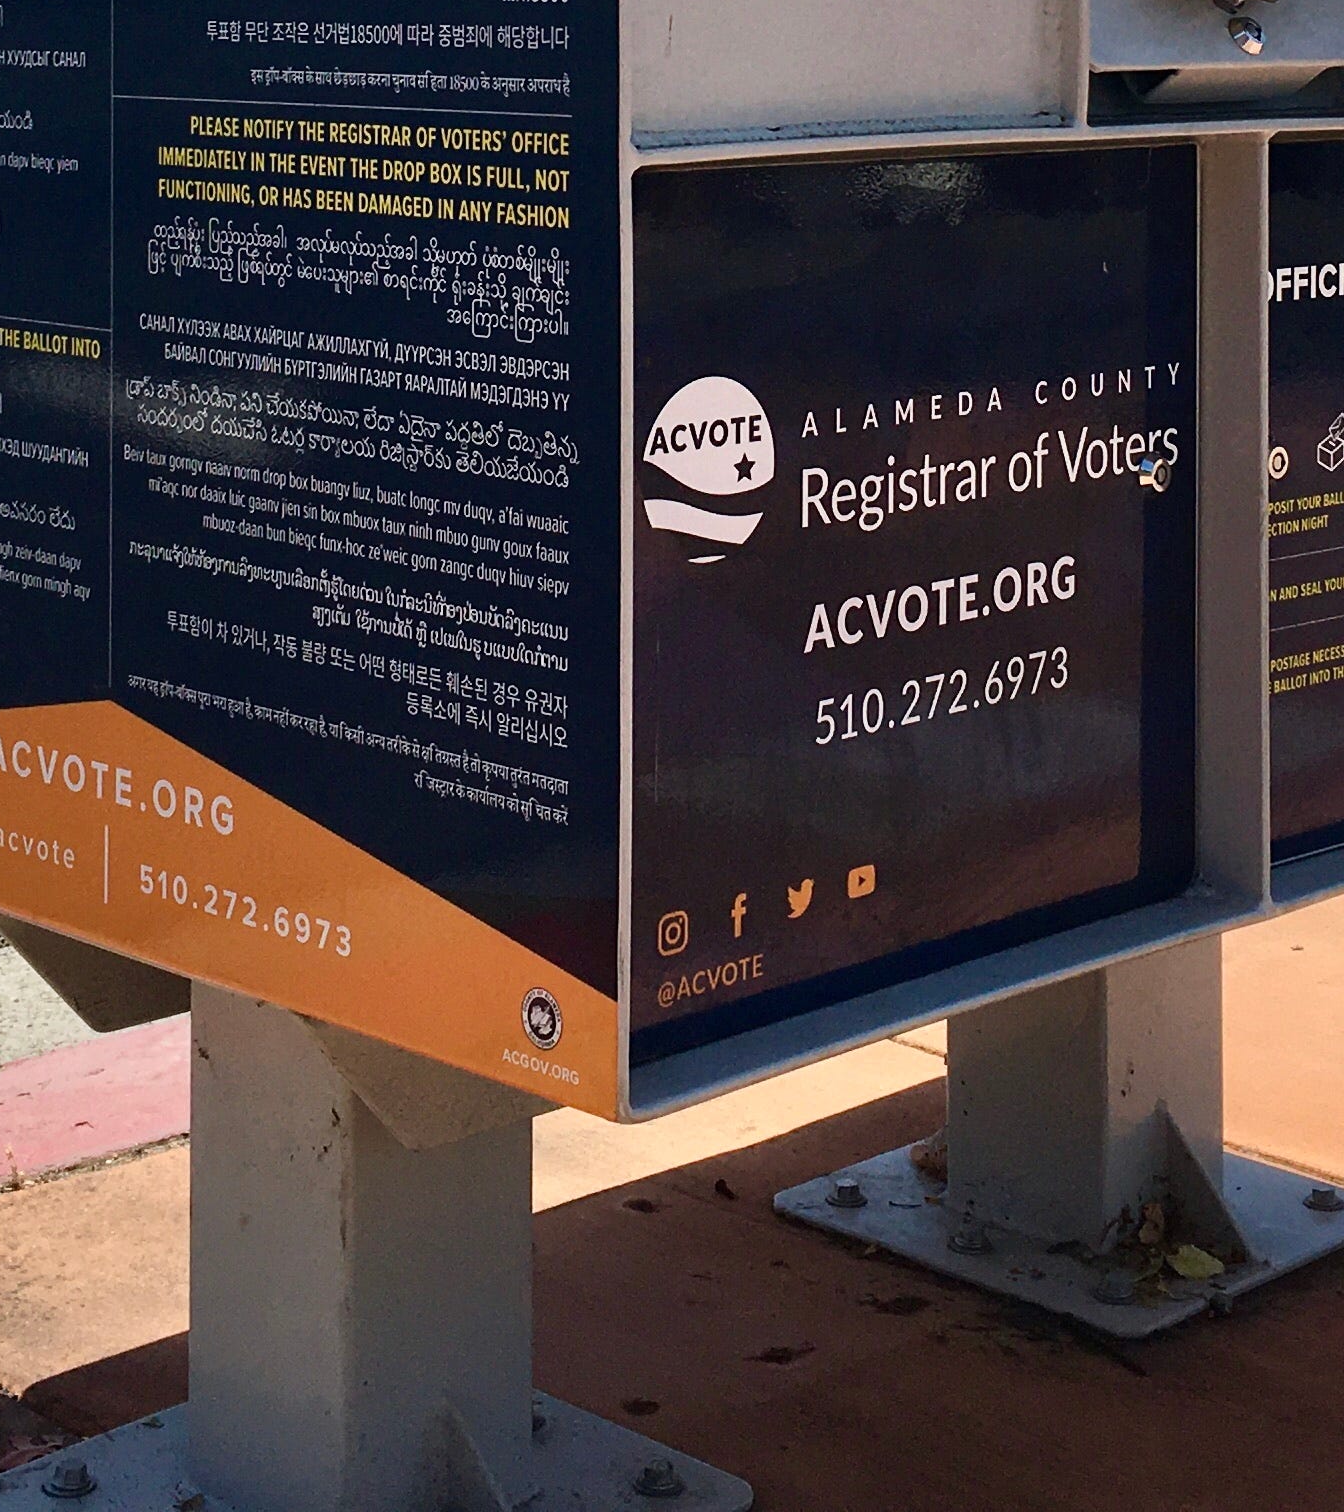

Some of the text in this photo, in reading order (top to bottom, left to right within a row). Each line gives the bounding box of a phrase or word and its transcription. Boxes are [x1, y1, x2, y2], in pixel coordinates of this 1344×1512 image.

[190, 115, 239, 137] PLEASE
[243, 118, 294, 140] NOTIFY
[297, 120, 324, 142] THE
[329, 122, 411, 146] REGISTRAR
[416, 126, 436, 148] OF
[511, 130, 569, 155] OFFICE
[158, 146, 570, 192] IMMEDIATELY IN THE EVENT THE DROP BOX IS FULL, NOT
[158, 178, 569, 228] FUNCTIONING, OR HAS BEEN DAMAGED IN ANY FASHION
[23, 330, 68, 354] BALLOT
[71, 337, 100, 359] INTO
[801, 361, 1180, 438] ALAMEDA COUNTY
[649, 414, 762, 456] ACVOTE
[801, 424, 1178, 530] Registrar of Voters
[1269, 499, 1294, 515] POSIT
[1296, 495, 1321, 510] YOUR
[1301, 514, 1329, 532] NIGHT
[803, 555, 1075, 653] ACVOTE.ORG
[815, 646, 1068, 745] 510.272.6973
[140, 863, 351, 960] 510.272.6973
[657, 953, 763, 1008] @ACVOTE
[502, 1048, 579, 1085] ACGOV.ORG
